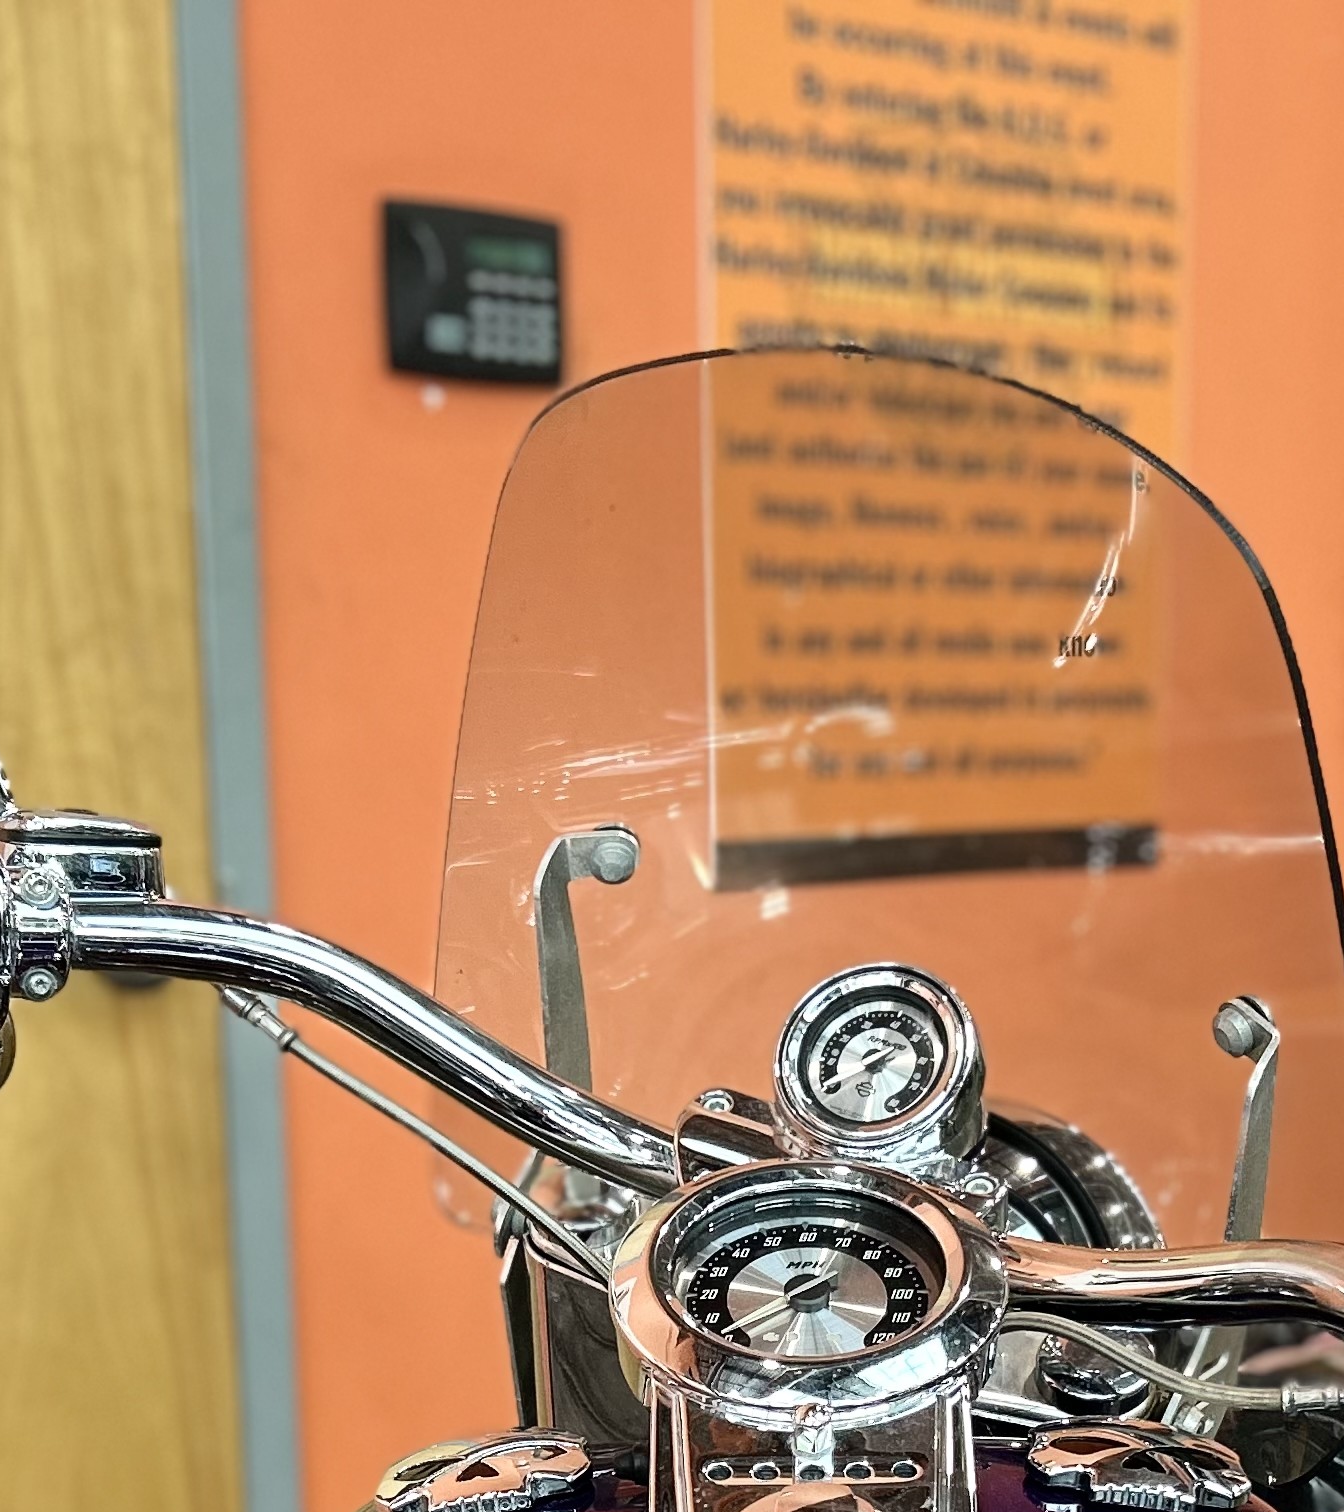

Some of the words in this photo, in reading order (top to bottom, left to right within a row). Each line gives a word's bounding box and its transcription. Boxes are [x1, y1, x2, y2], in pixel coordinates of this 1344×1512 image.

[763, 1236, 782, 1247] 50
[835, 1237, 852, 1248] 70
[731, 1247, 750, 1259] 40
[862, 1250, 881, 1260] 80
[709, 1266, 729, 1277] 30
[884, 1267, 903, 1278] 90
[699, 1288, 719, 1300] 20
[890, 1288, 914, 1300] 100
[704, 1312, 720, 1324] 10
[891, 1311, 912, 1323] 110
